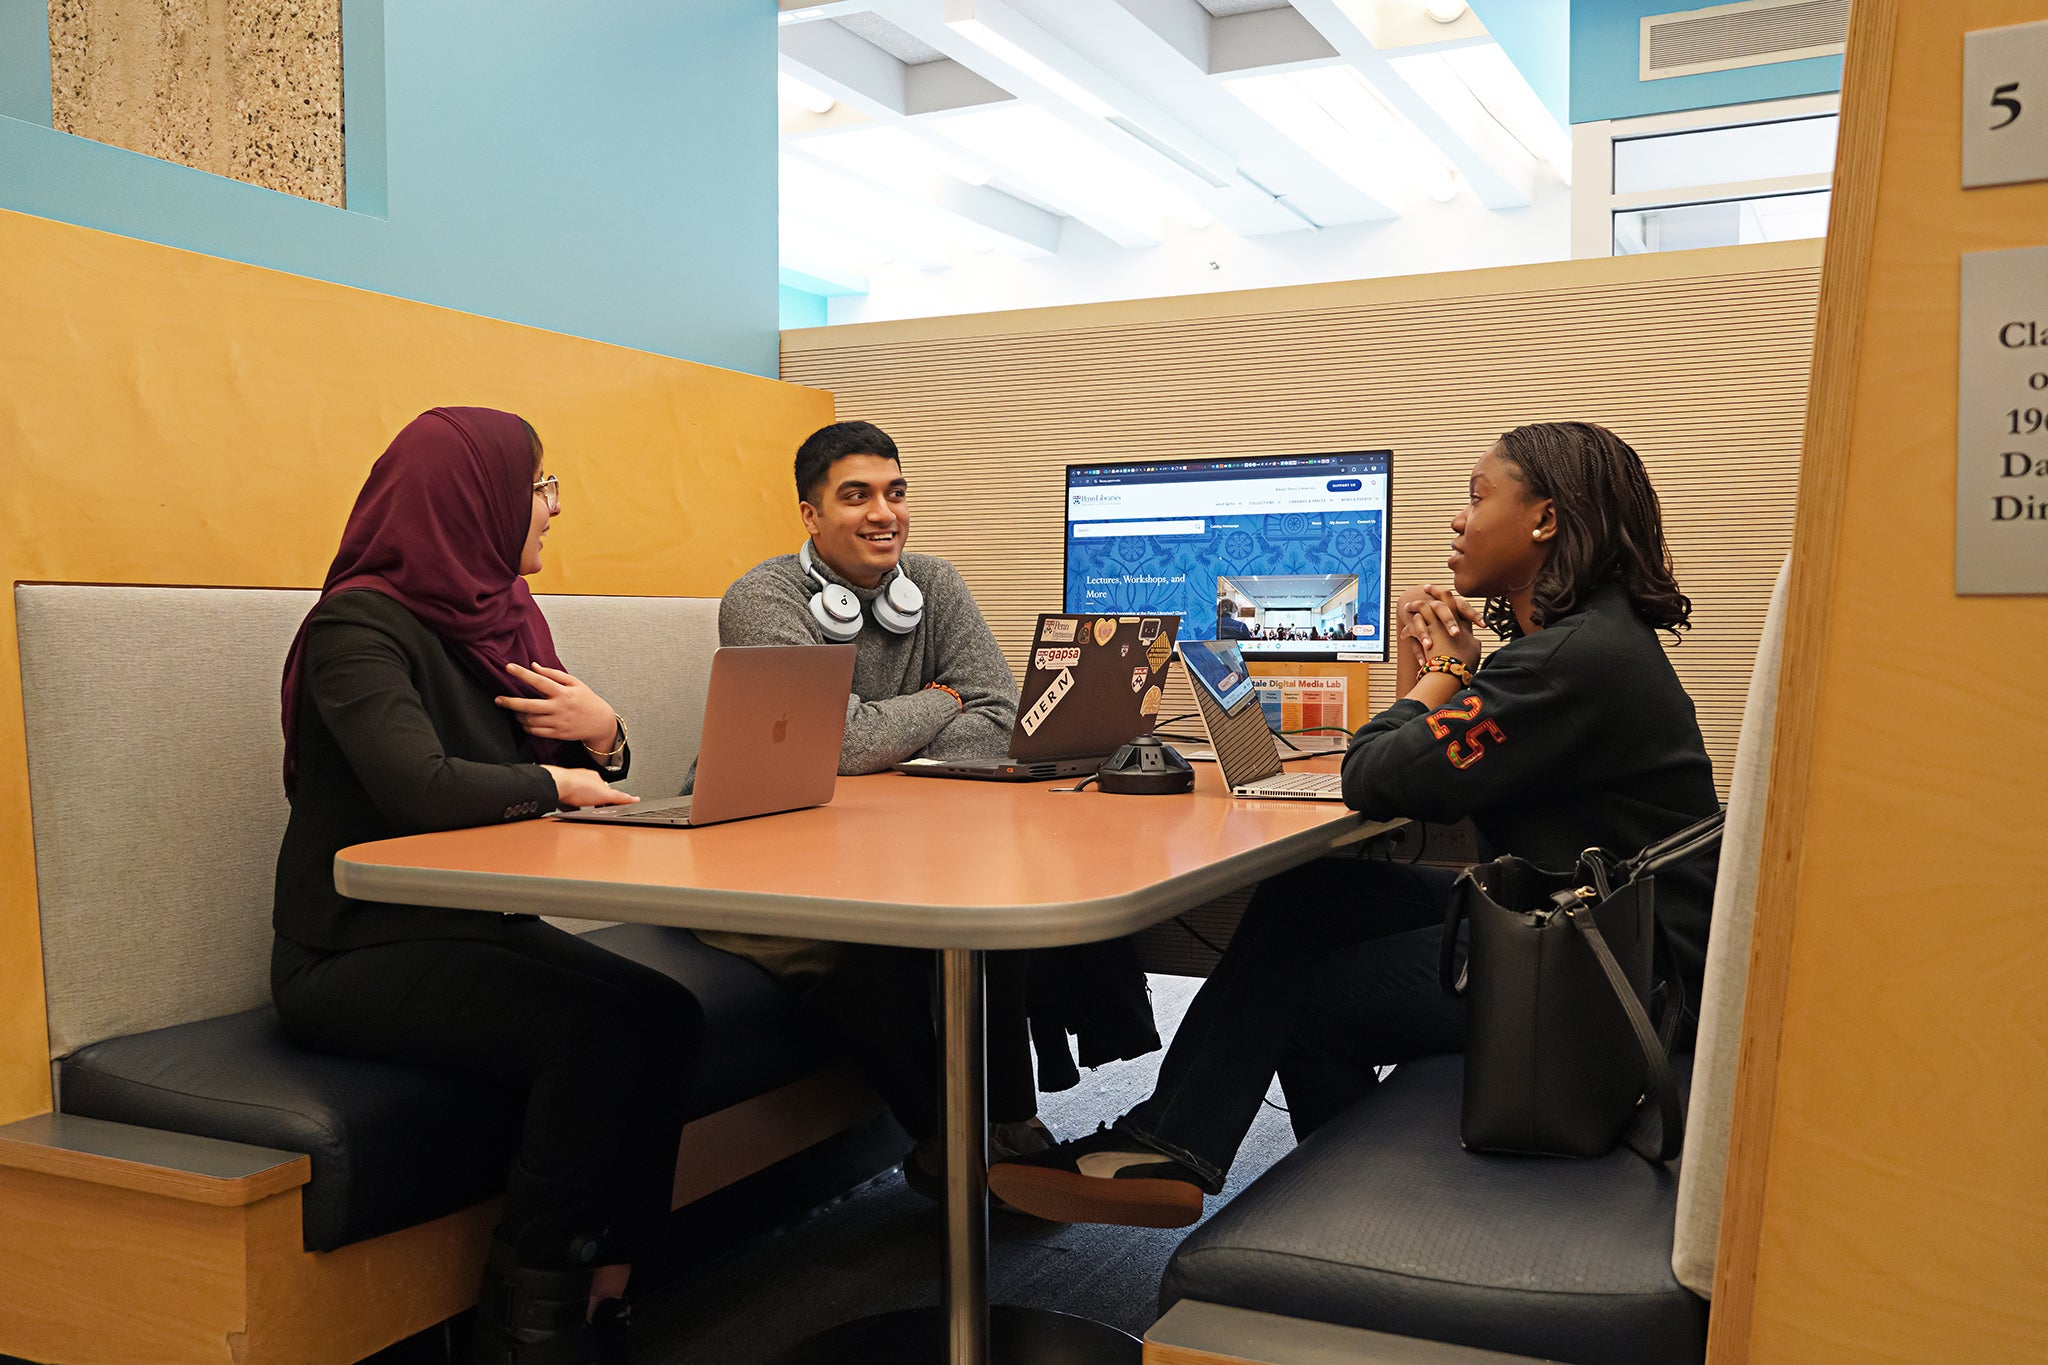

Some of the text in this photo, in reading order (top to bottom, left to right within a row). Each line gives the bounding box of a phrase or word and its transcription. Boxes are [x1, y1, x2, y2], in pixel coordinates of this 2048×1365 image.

[1989, 82, 2022, 130] 5
[2006, 407, 2048, 434] 19
[1086, 574, 1185, 586] Lectures, Workshops, and
[1086, 590, 1107, 598] More
[1054, 620, 1070, 630] Penn
[1048, 649, 1079, 661] gapsa
[1269, 680, 1296, 689] Digital
[1298, 680, 1324, 688] Media
[1326, 680, 1341, 688] Lab
[1025, 691, 1057, 728] TIER
[1426, 695, 1507, 769] 25
